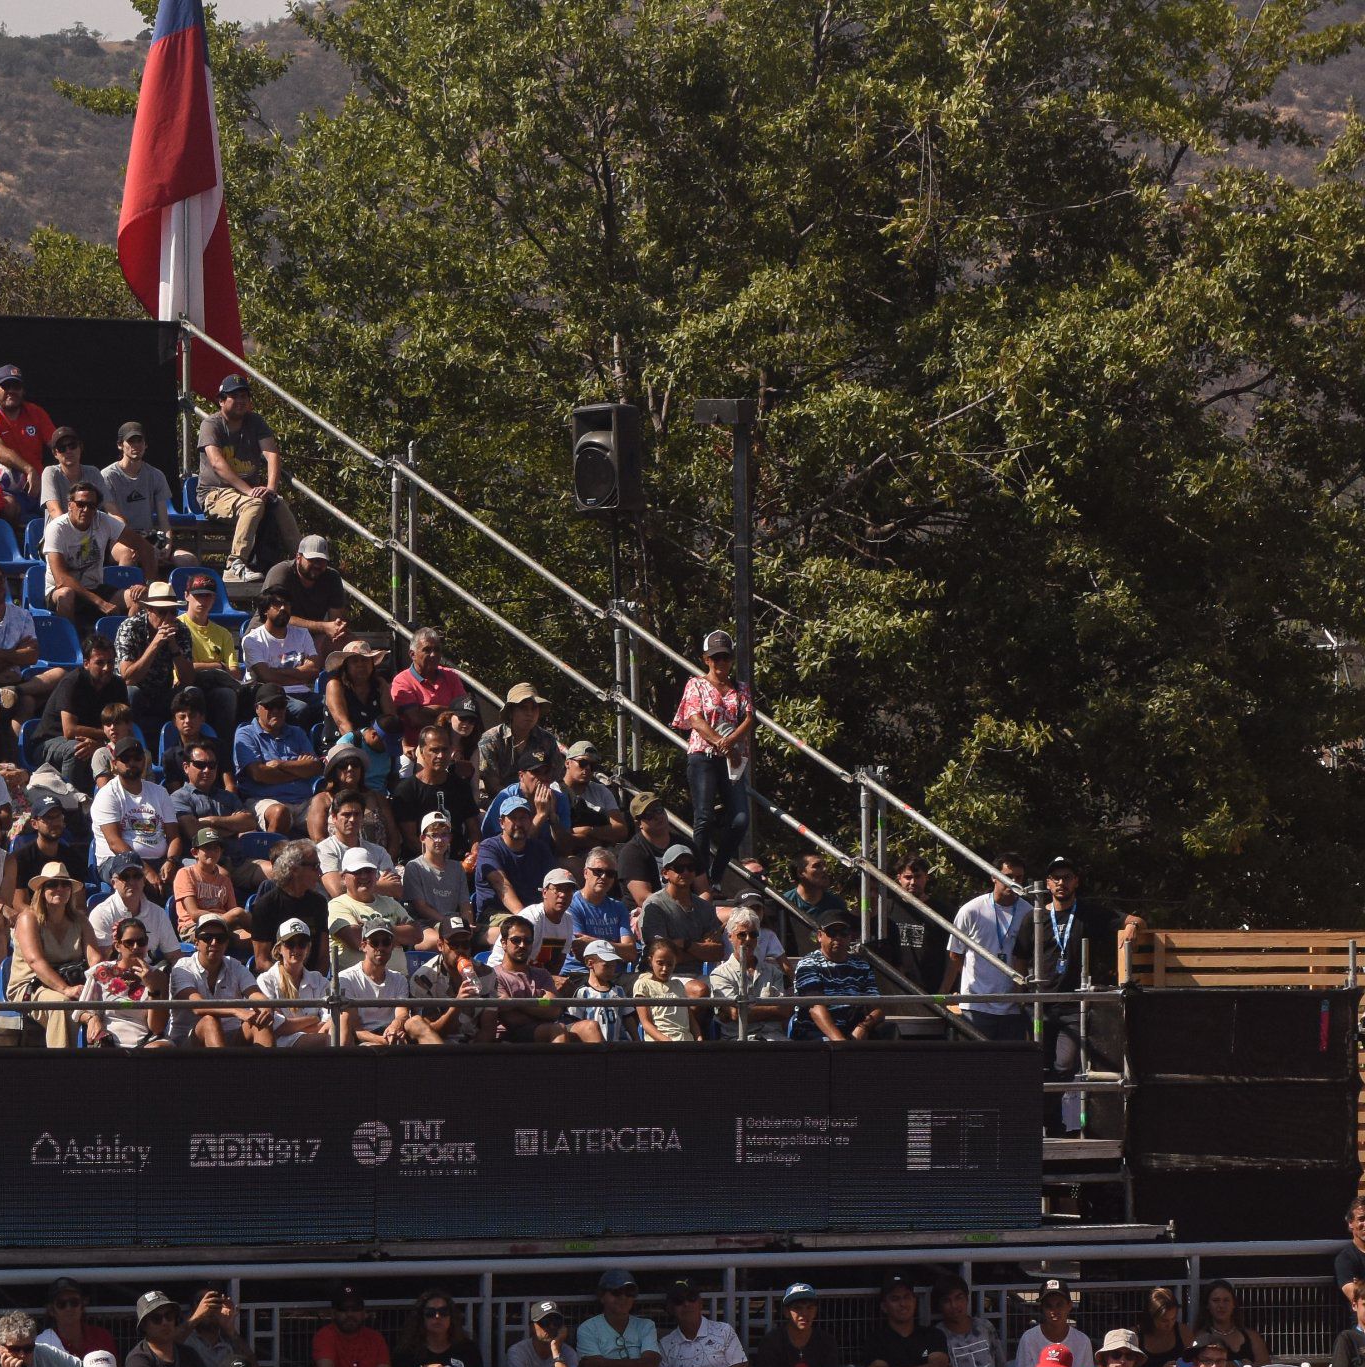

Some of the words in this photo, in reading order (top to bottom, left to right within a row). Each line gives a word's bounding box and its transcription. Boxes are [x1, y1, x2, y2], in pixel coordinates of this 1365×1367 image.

[399, 1119, 446, 1141] TNT
[745, 1116, 802, 1129] Gobierno
[804, 1115, 859, 1131] Regional
[745, 1133, 831, 1148] Metropolitano
[834, 1134, 849, 1145] de
[65, 1133, 152, 1168] Ashley
[399, 1142, 479, 1165] SPORTS
[745, 1152, 801, 1167] Santiago
